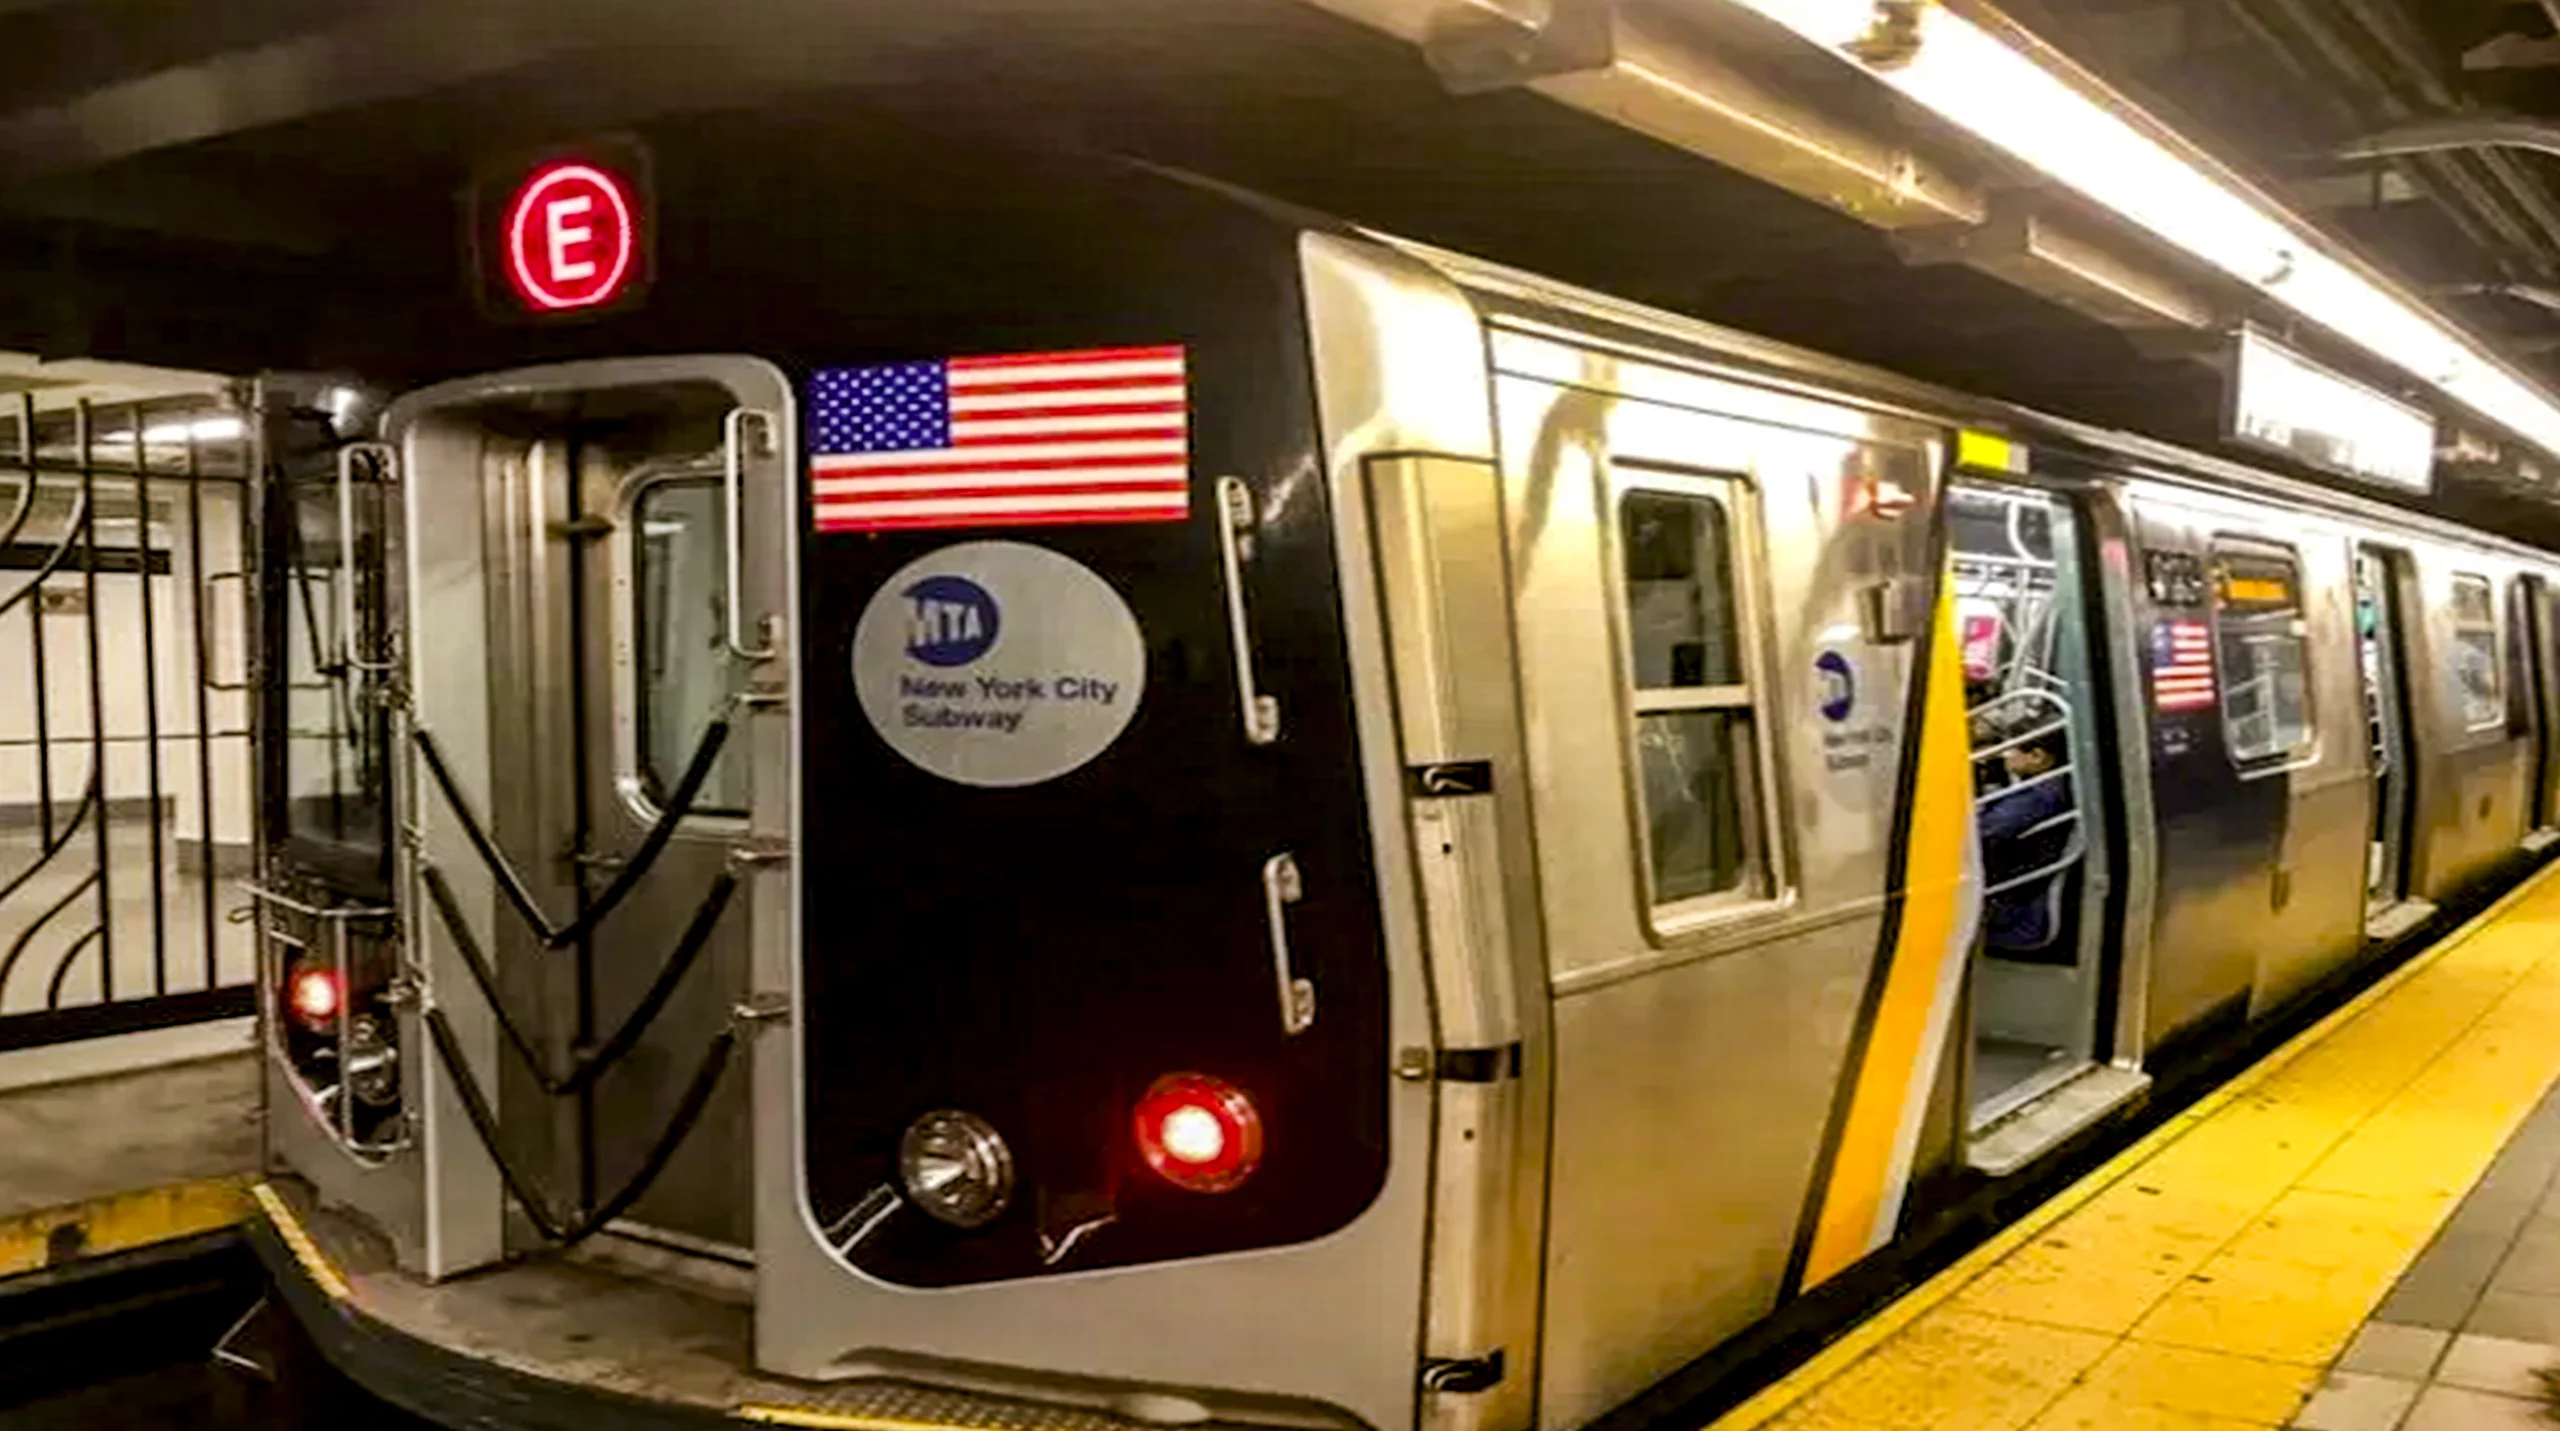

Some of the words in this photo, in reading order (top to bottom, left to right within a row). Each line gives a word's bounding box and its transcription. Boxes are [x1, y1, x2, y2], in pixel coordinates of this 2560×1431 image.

[547, 195, 596, 282] E
[903, 597, 983, 648] MTA
[900, 676, 966, 699] New
[976, 677, 1047, 700] York
[1054, 676, 1118, 706] City
[902, 703, 1023, 734] Subway
